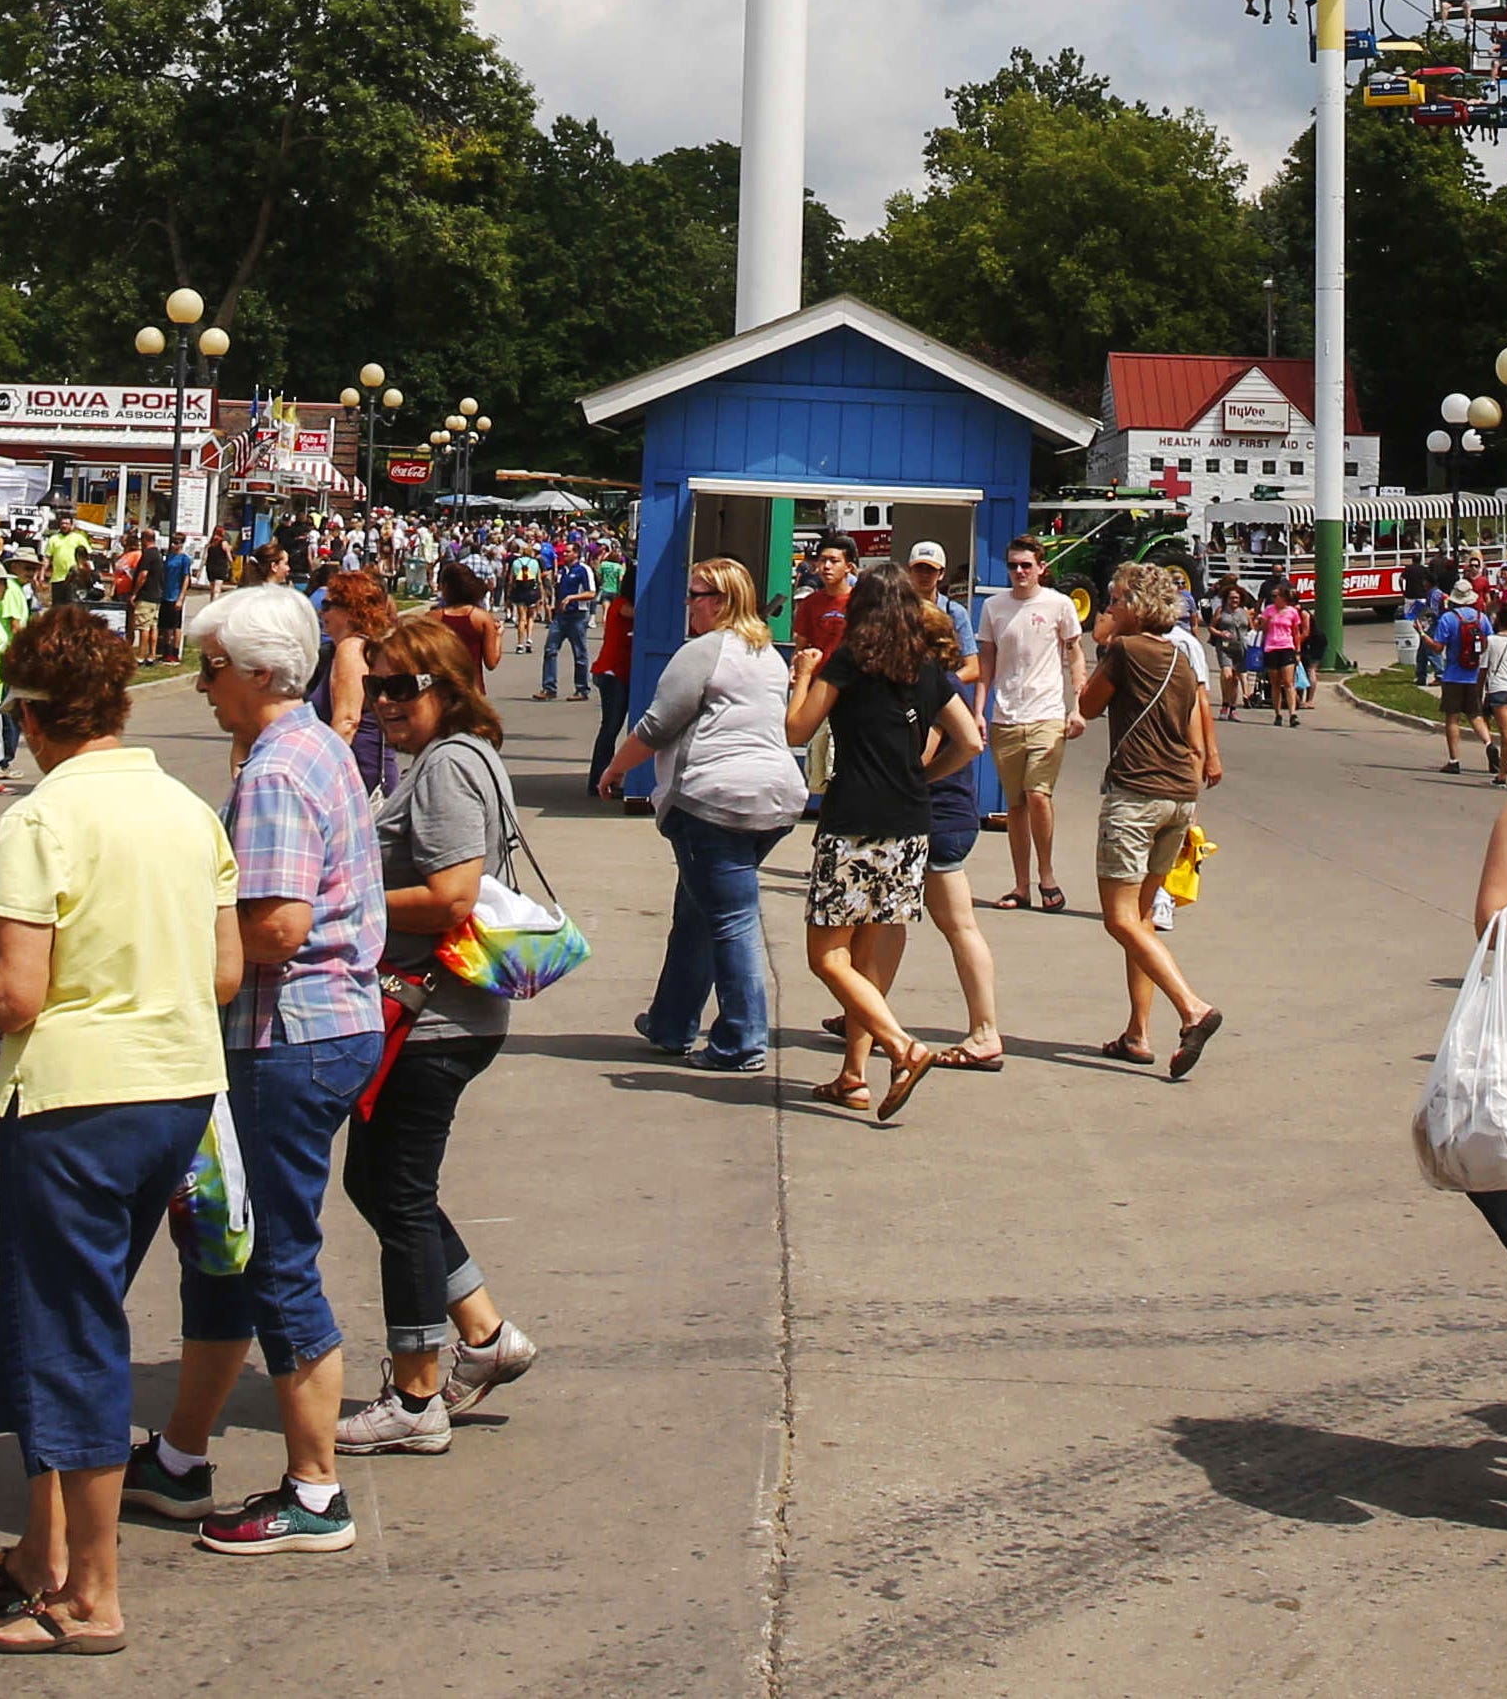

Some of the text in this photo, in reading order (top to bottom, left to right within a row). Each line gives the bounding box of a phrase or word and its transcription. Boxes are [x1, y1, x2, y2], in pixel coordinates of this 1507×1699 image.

[27, 390, 110, 408] IOWA
[25, 408, 207, 421] PRODUCERS ASSOCIAION
[1159, 436, 1201, 447] HEALTH
[1208, 437, 1232, 448] AND
[1238, 438, 1270, 449] FIRST
[1280, 439, 1299, 450] AID
[391, 465, 427, 478] Coca-Cola
